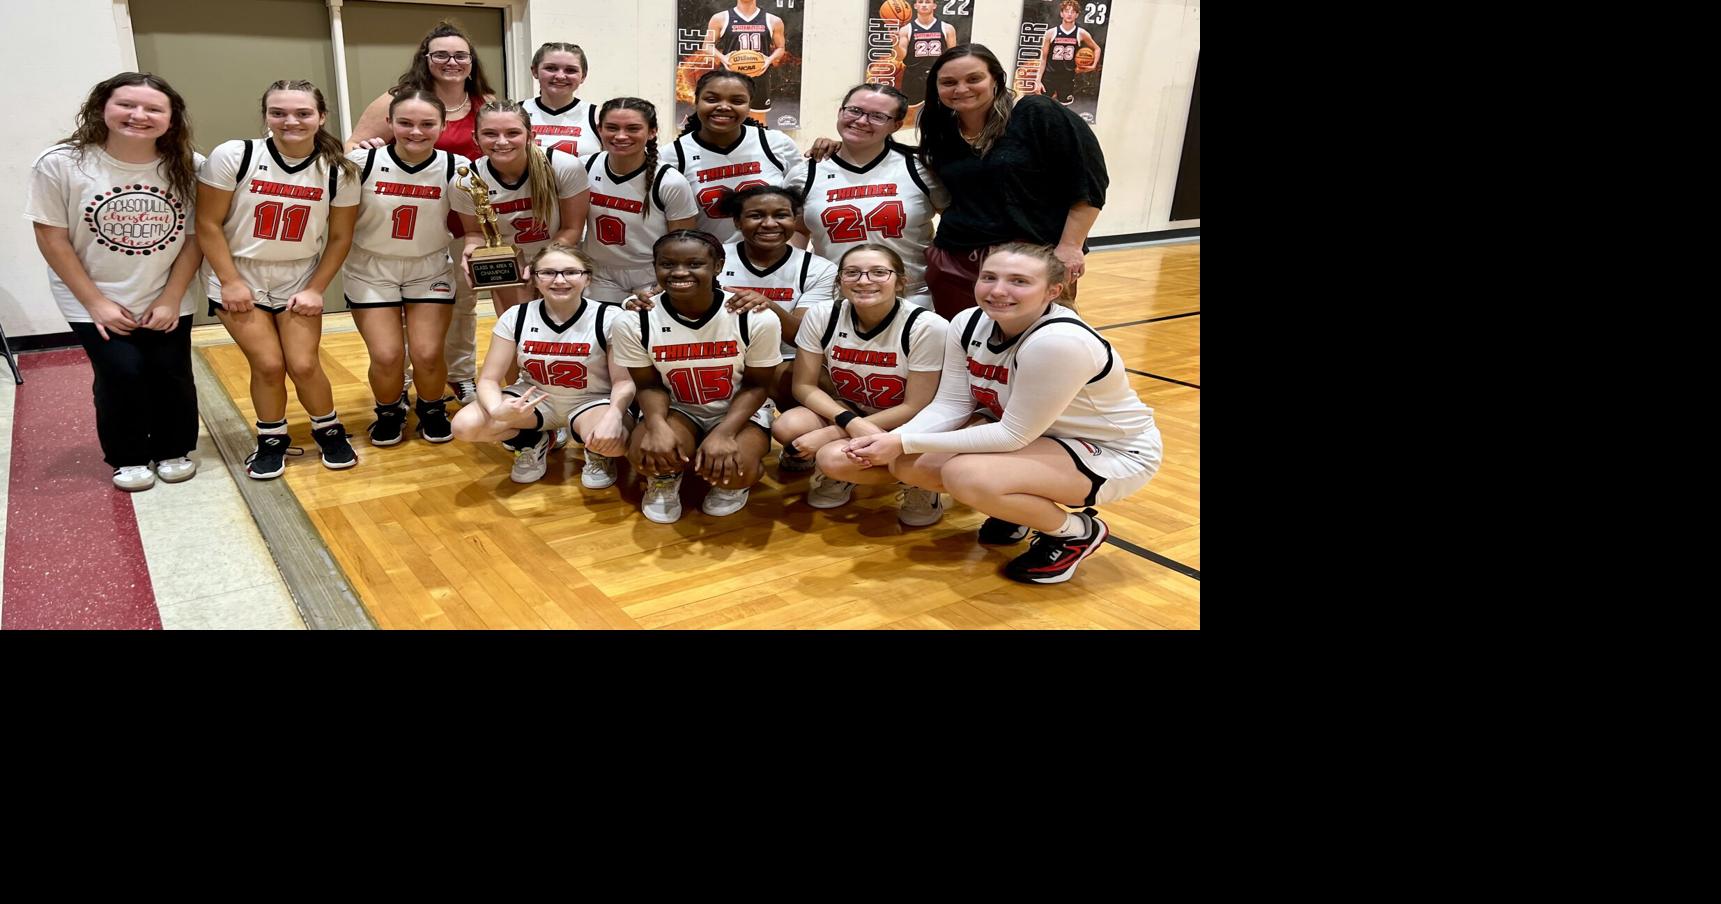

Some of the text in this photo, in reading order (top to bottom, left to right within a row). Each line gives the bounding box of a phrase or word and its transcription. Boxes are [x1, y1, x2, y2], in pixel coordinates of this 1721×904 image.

[1084, 3, 1107, 25] 23
[679, 28, 716, 70] LEE
[739, 33, 761, 51] 11
[914, 40, 941, 57] 22
[1052, 45, 1075, 60] 23
[531, 125, 582, 137] HUNDER
[697, 161, 763, 183] THUNDER
[249, 179, 324, 202] THUNDER
[374, 181, 442, 200] THUNDER
[696, 179, 770, 219] 2
[826, 183, 899, 202] THUNDER
[106, 199, 170, 213] JACKSONVILLE
[103, 222, 171, 238] ACADEMY
[253, 201, 312, 242] 11
[391, 204, 418, 240] 1
[820, 200, 907, 243] 24
[523, 340, 591, 357] THUNDER
[652, 340, 740, 362] THUNDER
[831, 345, 898, 368] THUNDER
[523, 358, 588, 390] 12
[665, 364, 734, 405] 15
[830, 366, 907, 410] 22
